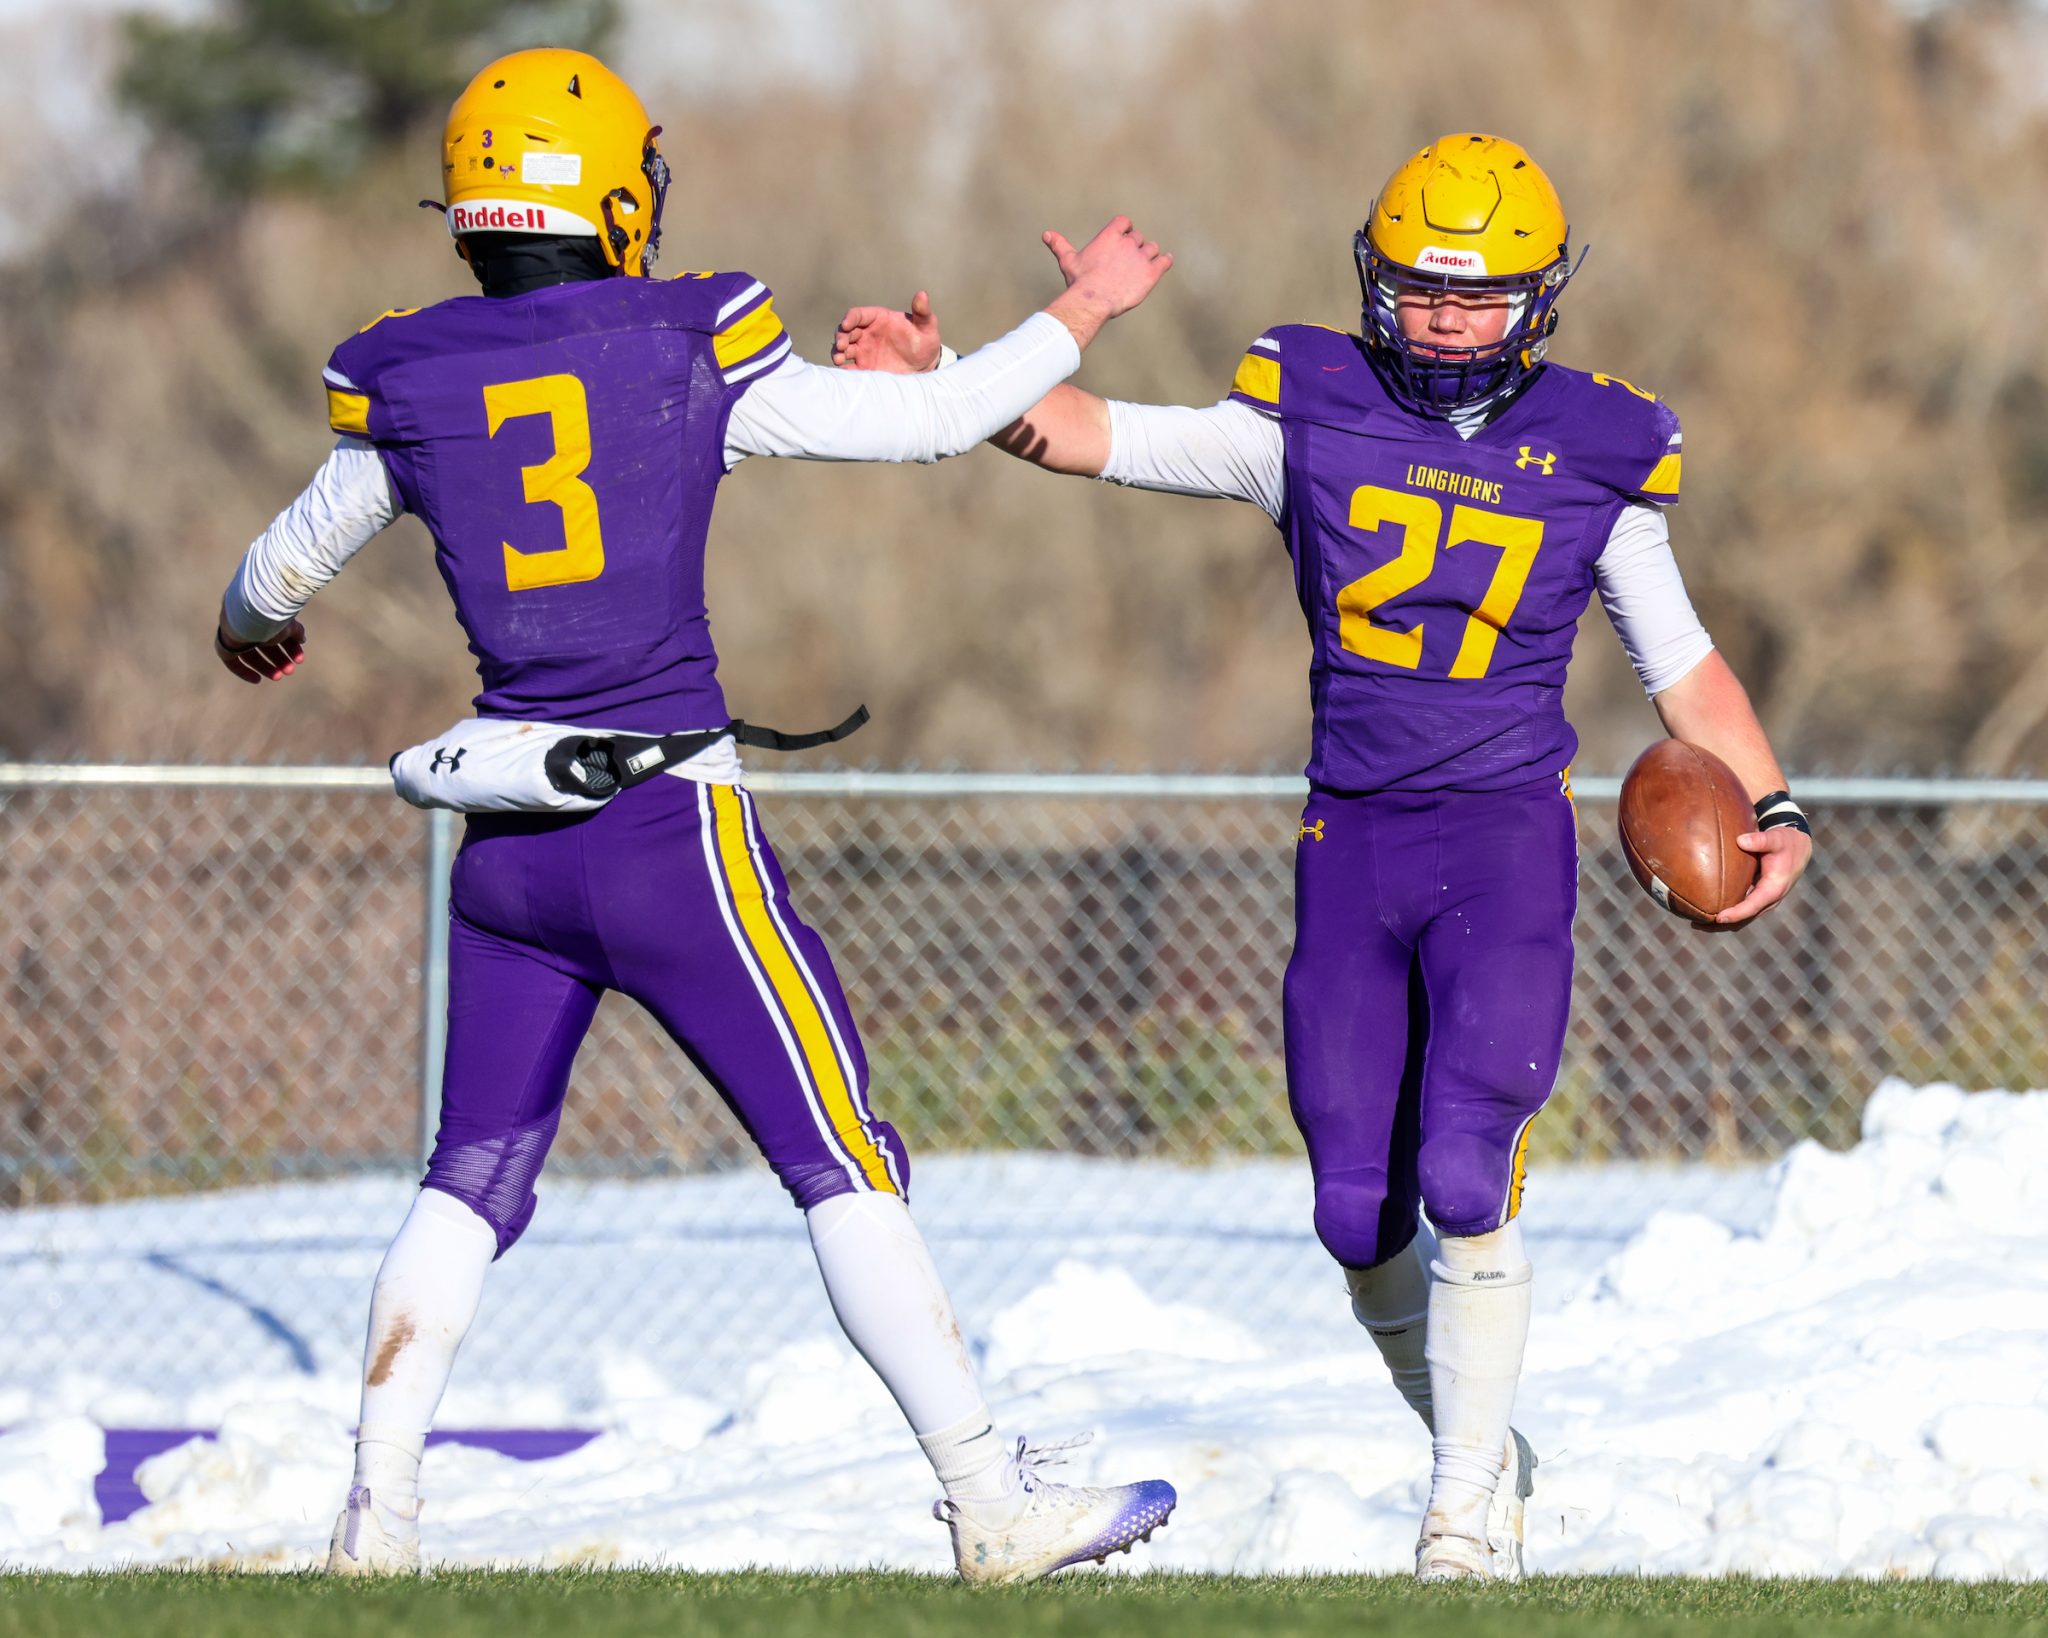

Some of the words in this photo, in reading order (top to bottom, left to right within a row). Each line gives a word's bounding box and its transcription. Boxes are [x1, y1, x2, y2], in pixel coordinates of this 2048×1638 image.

[482, 129, 493, 148] 3
[454, 206, 545, 230] Riddell
[483, 374, 605, 592] 3
[1406, 464, 1504, 505] LONGHORNS
[1336, 484, 1545, 679] 27
